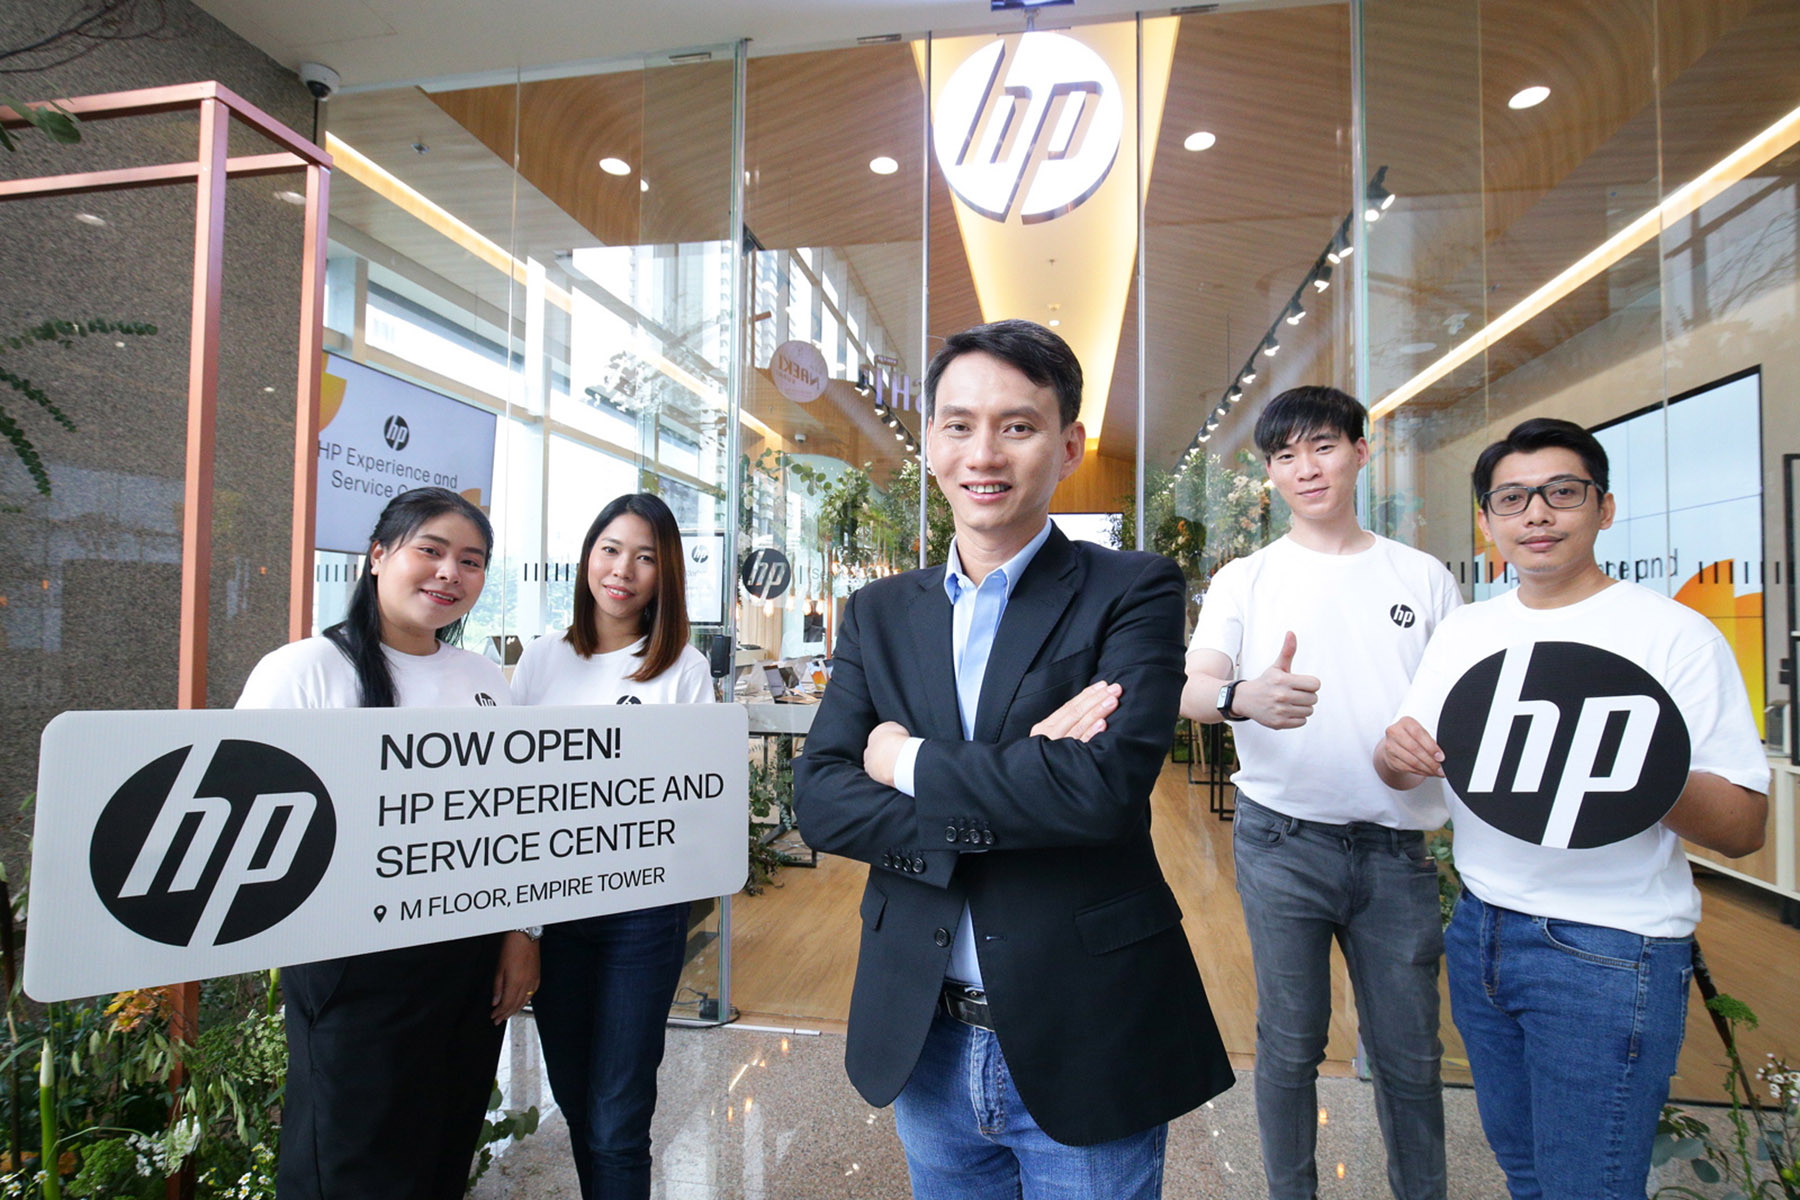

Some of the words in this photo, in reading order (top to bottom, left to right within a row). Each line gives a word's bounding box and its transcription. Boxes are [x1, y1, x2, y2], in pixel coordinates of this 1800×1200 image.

[950, 32, 1106, 225] hp
[385, 415, 409, 451] hp
[318, 440, 342, 461] HP
[347, 447, 430, 484] Experience
[433, 474, 458, 489] and
[331, 469, 393, 498] Service
[745, 549, 789, 602] hp
[1391, 604, 1415, 629] hp
[380, 731, 495, 770] NOW
[503, 727, 622, 764] OPEN!
[1456, 640, 1671, 849] hp
[378, 792, 434, 826] HP
[443, 777, 655, 821] EXPERIENCE
[662, 773, 724, 802] AND
[108, 740, 324, 948] hp
[376, 832, 540, 878] SERVICE
[549, 819, 676, 858] CENTER
[400, 900, 422, 921] M
[428, 888, 511, 918] FLOOR,
[516, 876, 593, 904] EMPIRE
[597, 866, 665, 892] TOWER
